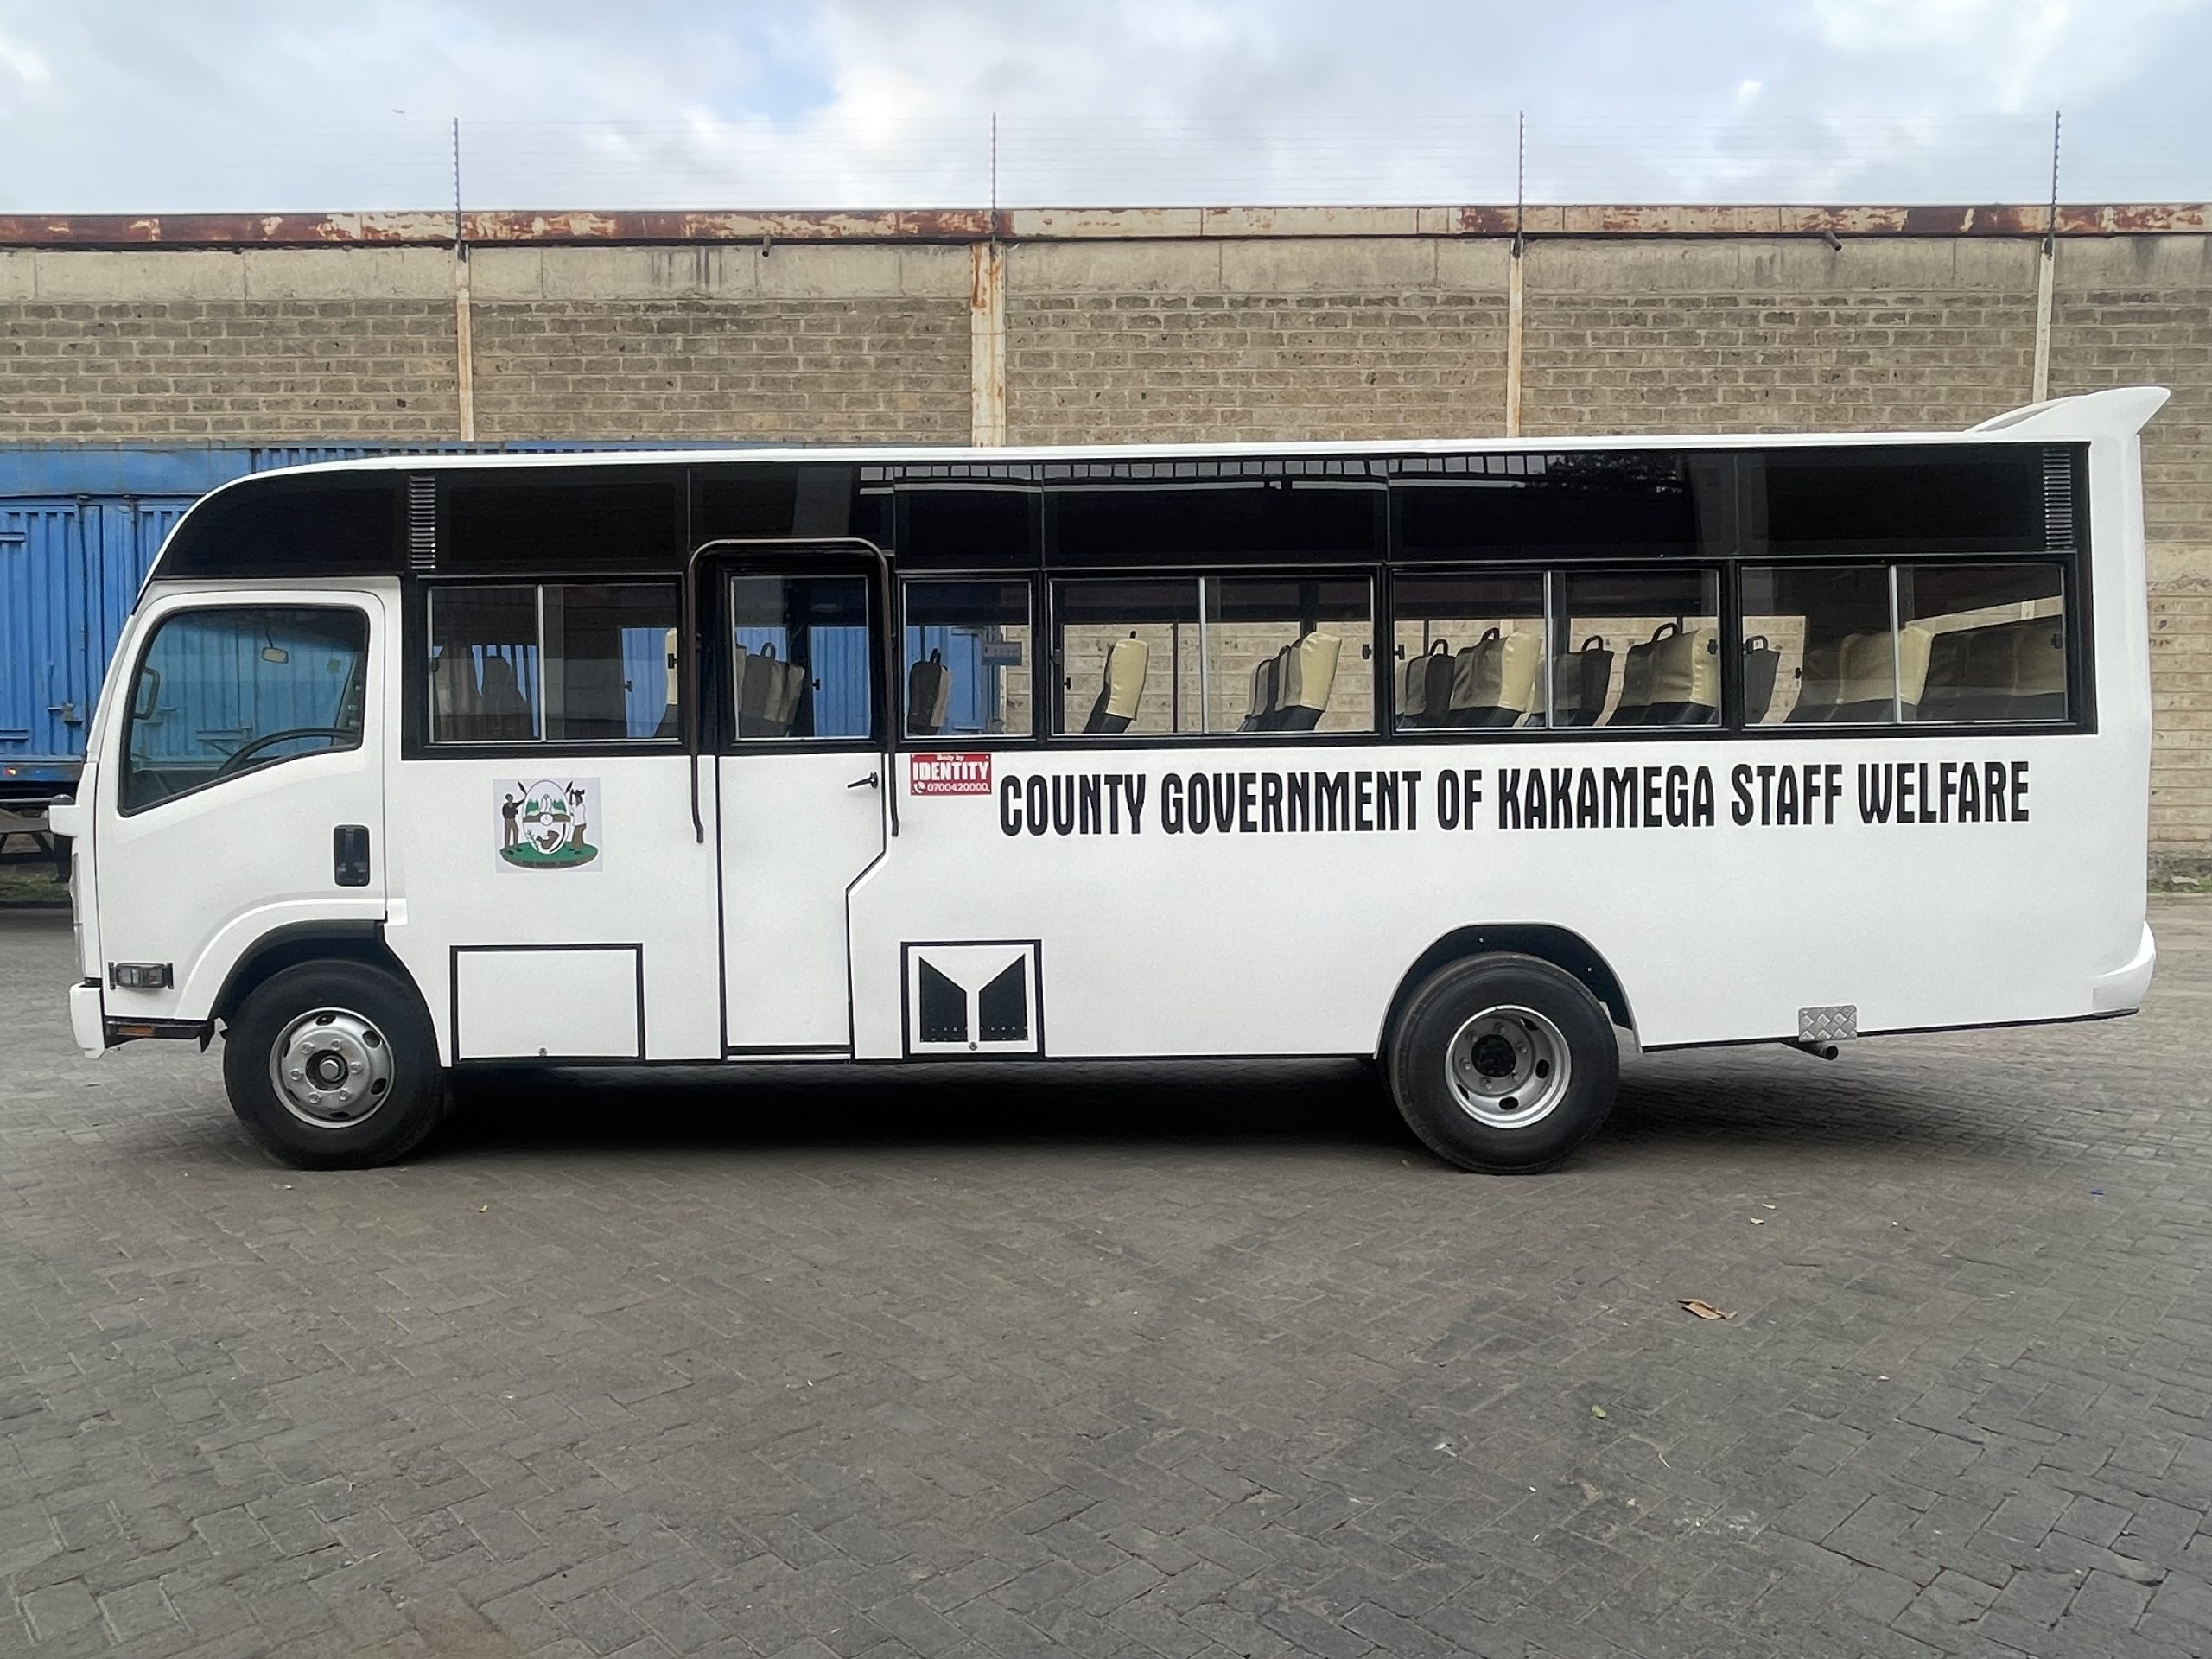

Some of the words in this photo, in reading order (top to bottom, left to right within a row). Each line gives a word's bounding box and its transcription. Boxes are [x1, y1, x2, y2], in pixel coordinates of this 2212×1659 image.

[912, 761, 989, 781] IDENTITY
[926, 782, 988, 792] 0700420000
[1000, 772, 1147, 836] COUNTY
[1160, 770, 1422, 835] GOVERNMENT
[1437, 769, 1483, 831] OF
[1498, 765, 1715, 830] KAKAMEGA
[1731, 763, 1842, 826] STAFF
[1858, 761, 2030, 824] WELFARE
